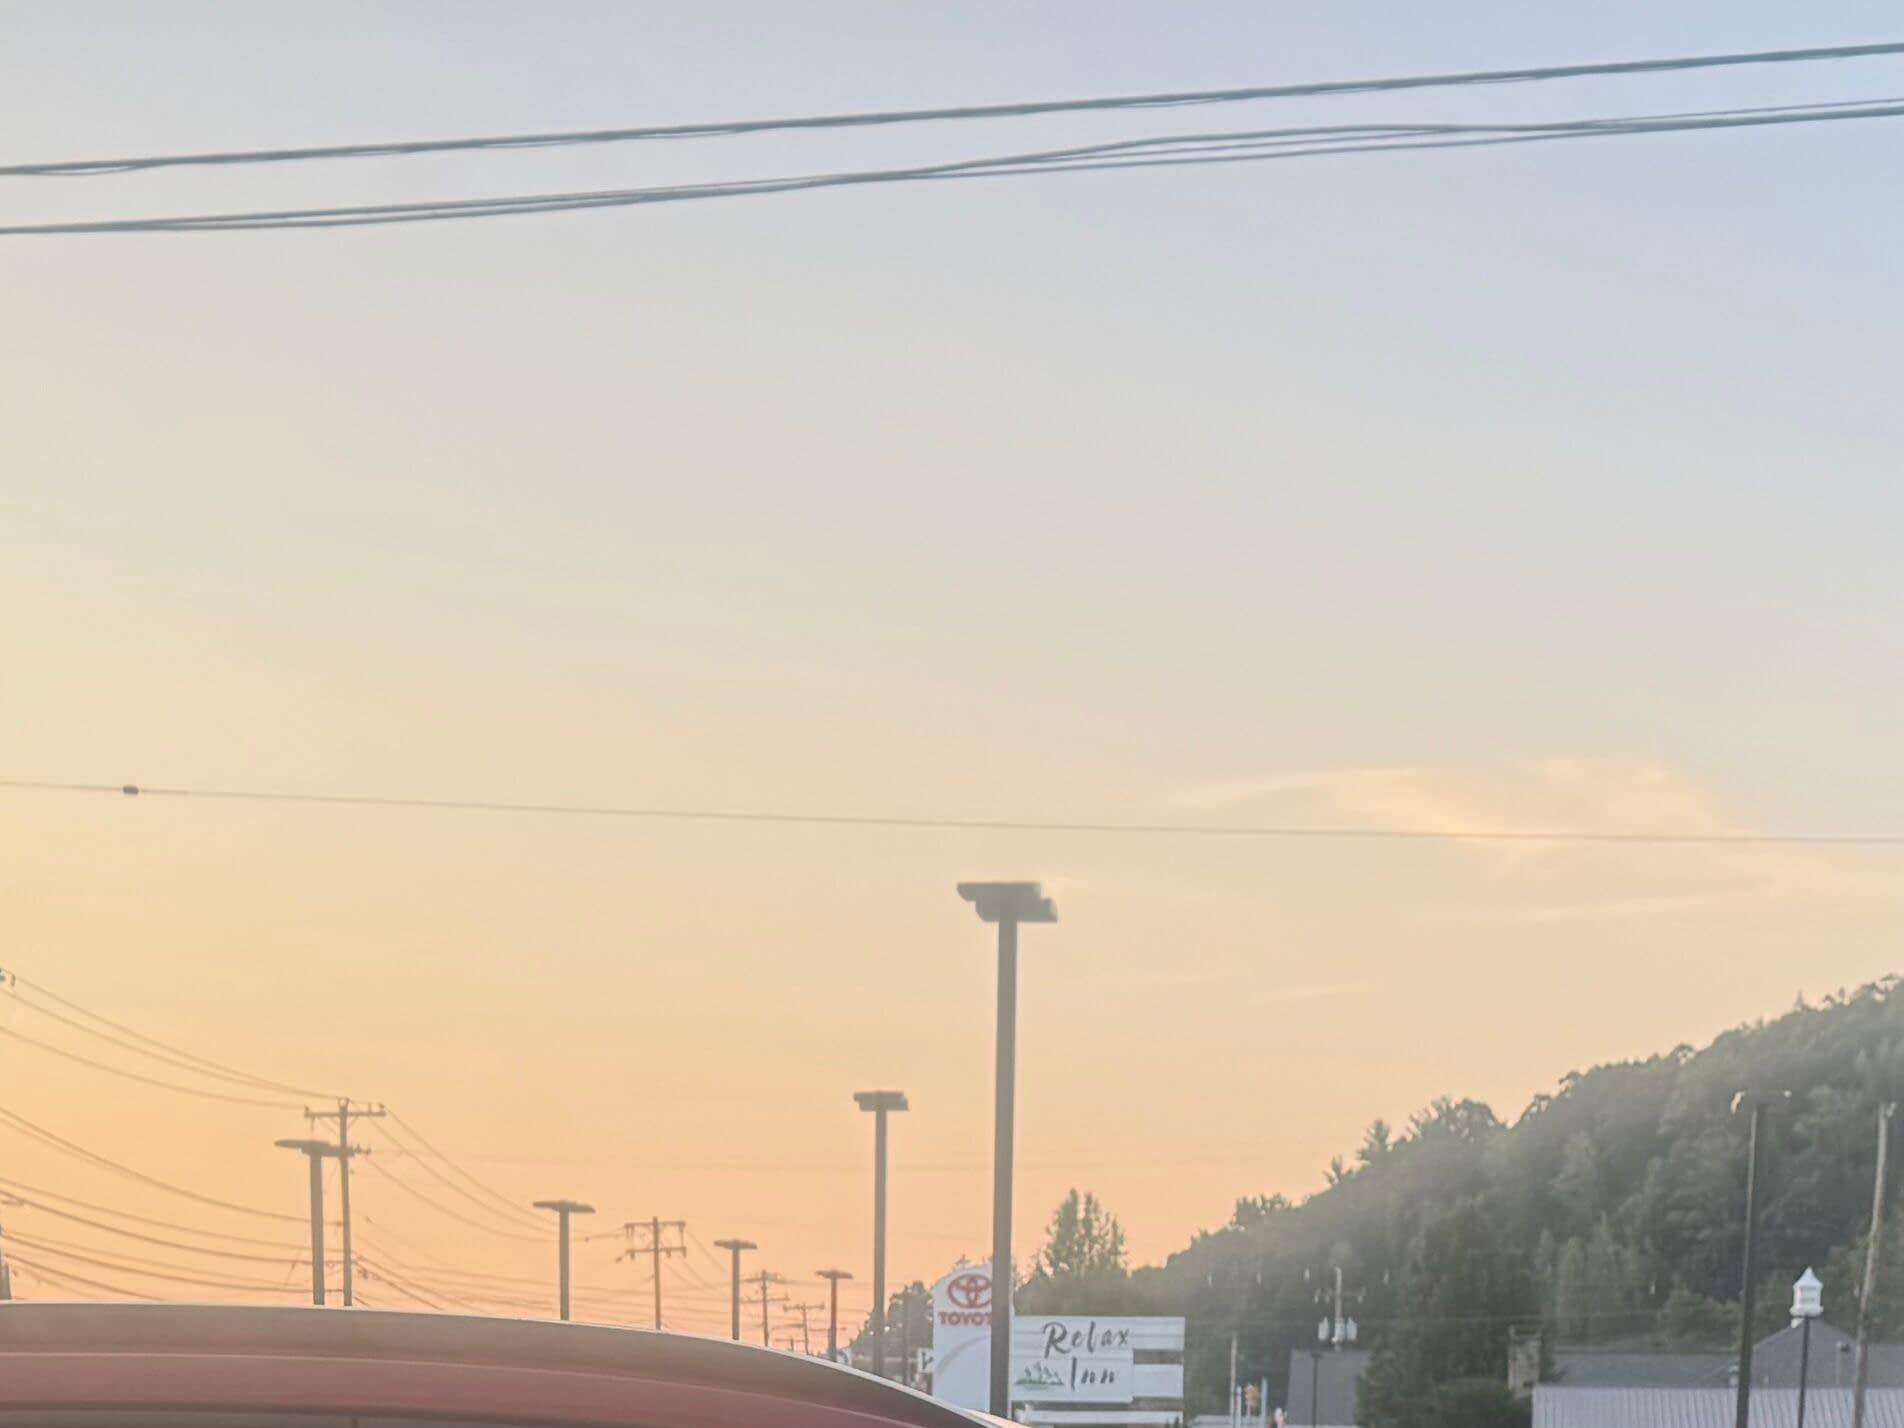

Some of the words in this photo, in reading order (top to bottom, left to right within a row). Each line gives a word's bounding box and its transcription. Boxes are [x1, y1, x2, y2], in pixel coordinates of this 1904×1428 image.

[938, 1311, 993, 1326] TOYOT
[1043, 1320, 1130, 1359] Relax
[1070, 1356, 1116, 1392] Inn
